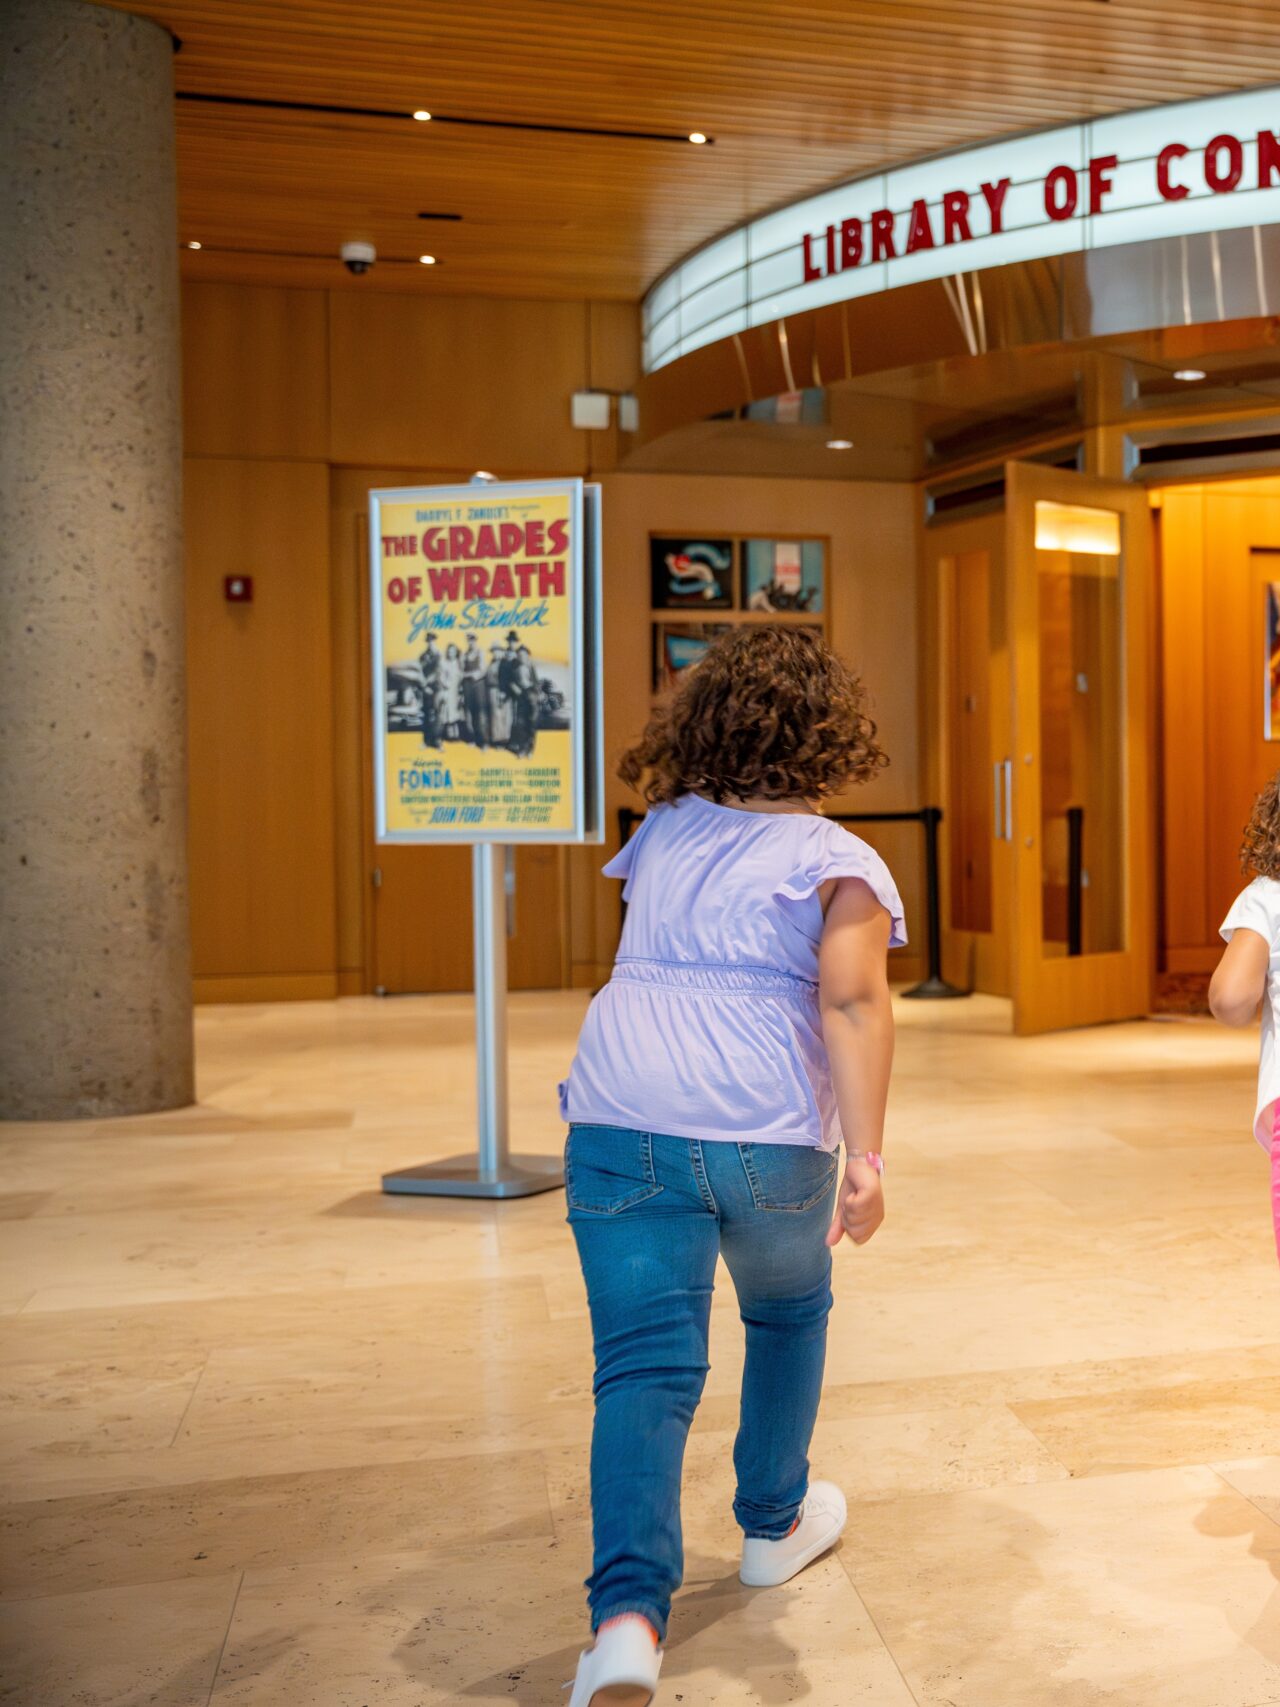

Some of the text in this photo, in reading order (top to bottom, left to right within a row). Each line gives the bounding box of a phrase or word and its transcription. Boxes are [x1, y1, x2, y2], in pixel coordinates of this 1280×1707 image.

[802, 177, 1012, 284] LIBRARY
[1044, 155, 1119, 221] OF
[382, 519, 569, 562] THE GRAPES
[387, 561, 566, 604] OF WRATH
[407, 597, 549, 644] John Steinbeck
[399, 769, 453, 790] FONDA
[429, 806, 458, 824] JOHN
[460, 805, 485, 824] FORD
